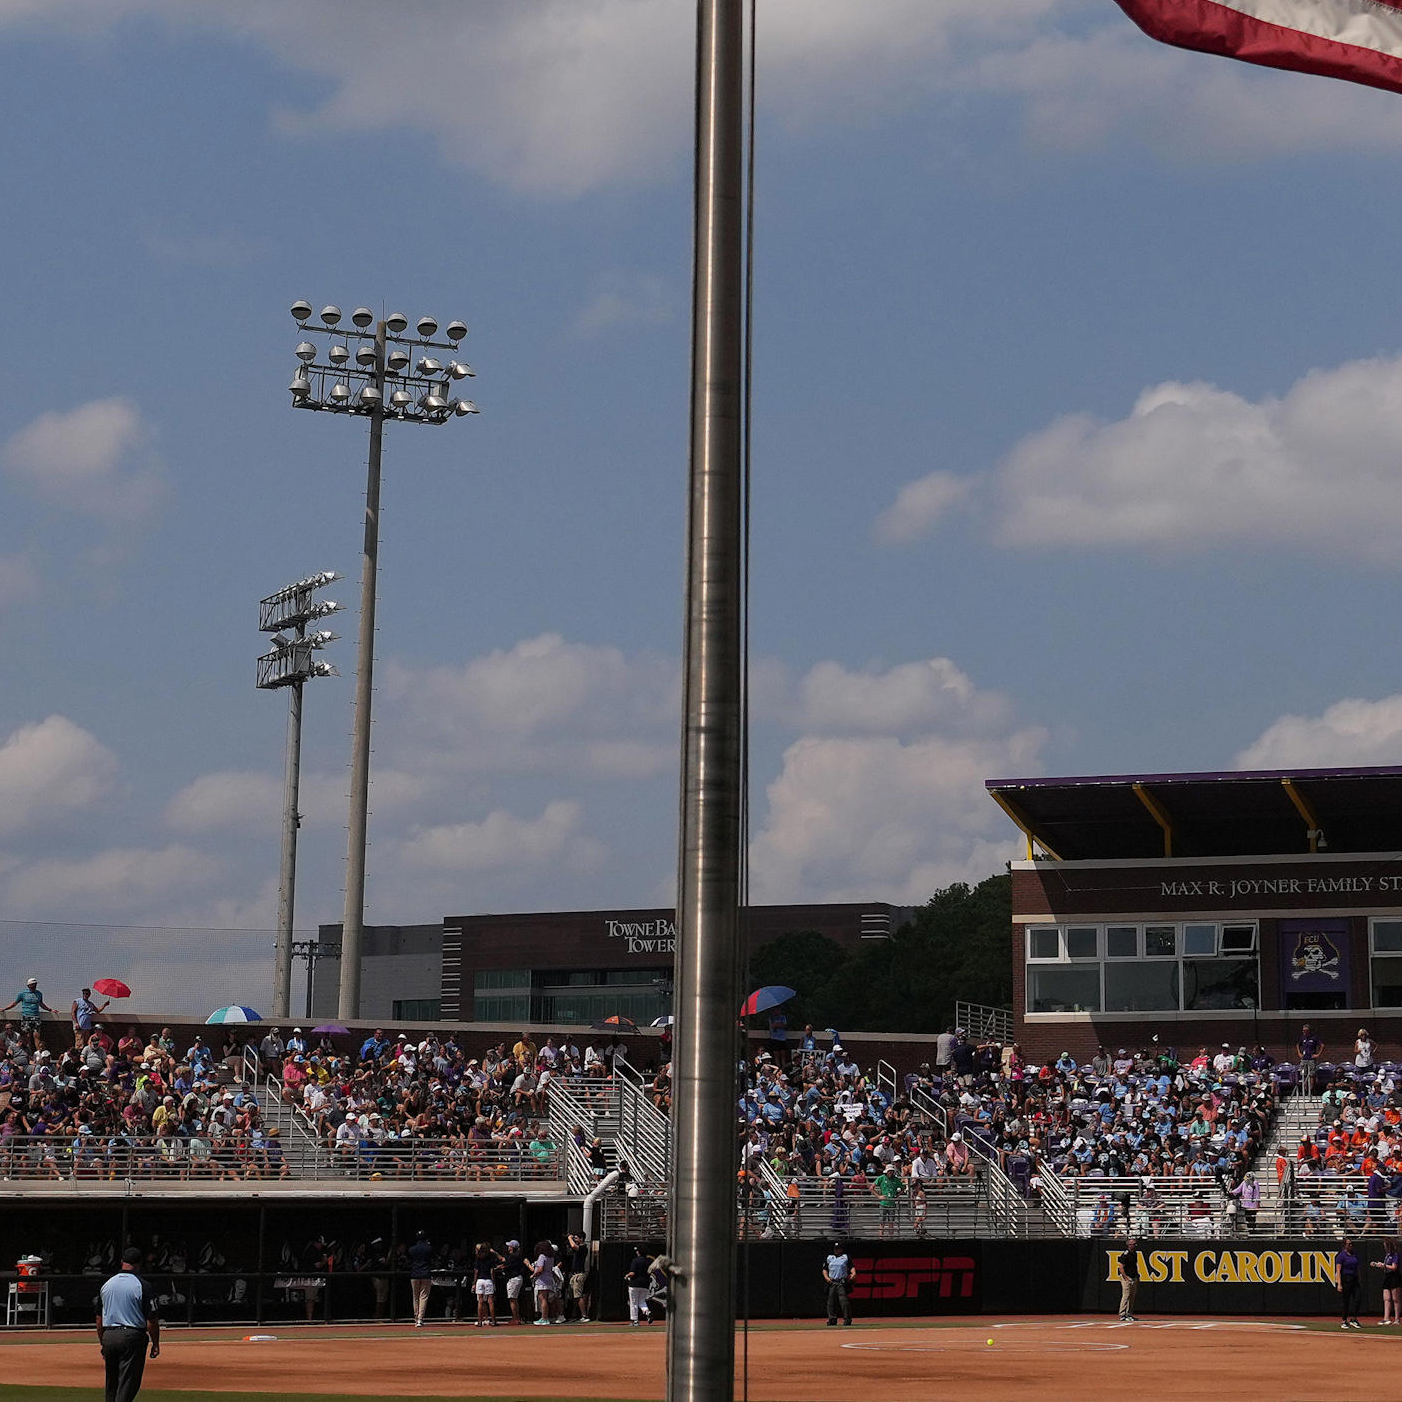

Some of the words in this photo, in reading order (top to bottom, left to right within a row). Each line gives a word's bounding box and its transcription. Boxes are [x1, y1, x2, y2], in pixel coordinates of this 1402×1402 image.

[1160, 881, 1204, 896] MAX
[1208, 880, 1226, 895] R.
[1229, 878, 1303, 899] JOYNER
[1307, 876, 1374, 893] FAMILY
[849, 1257, 975, 1299] ESPN
